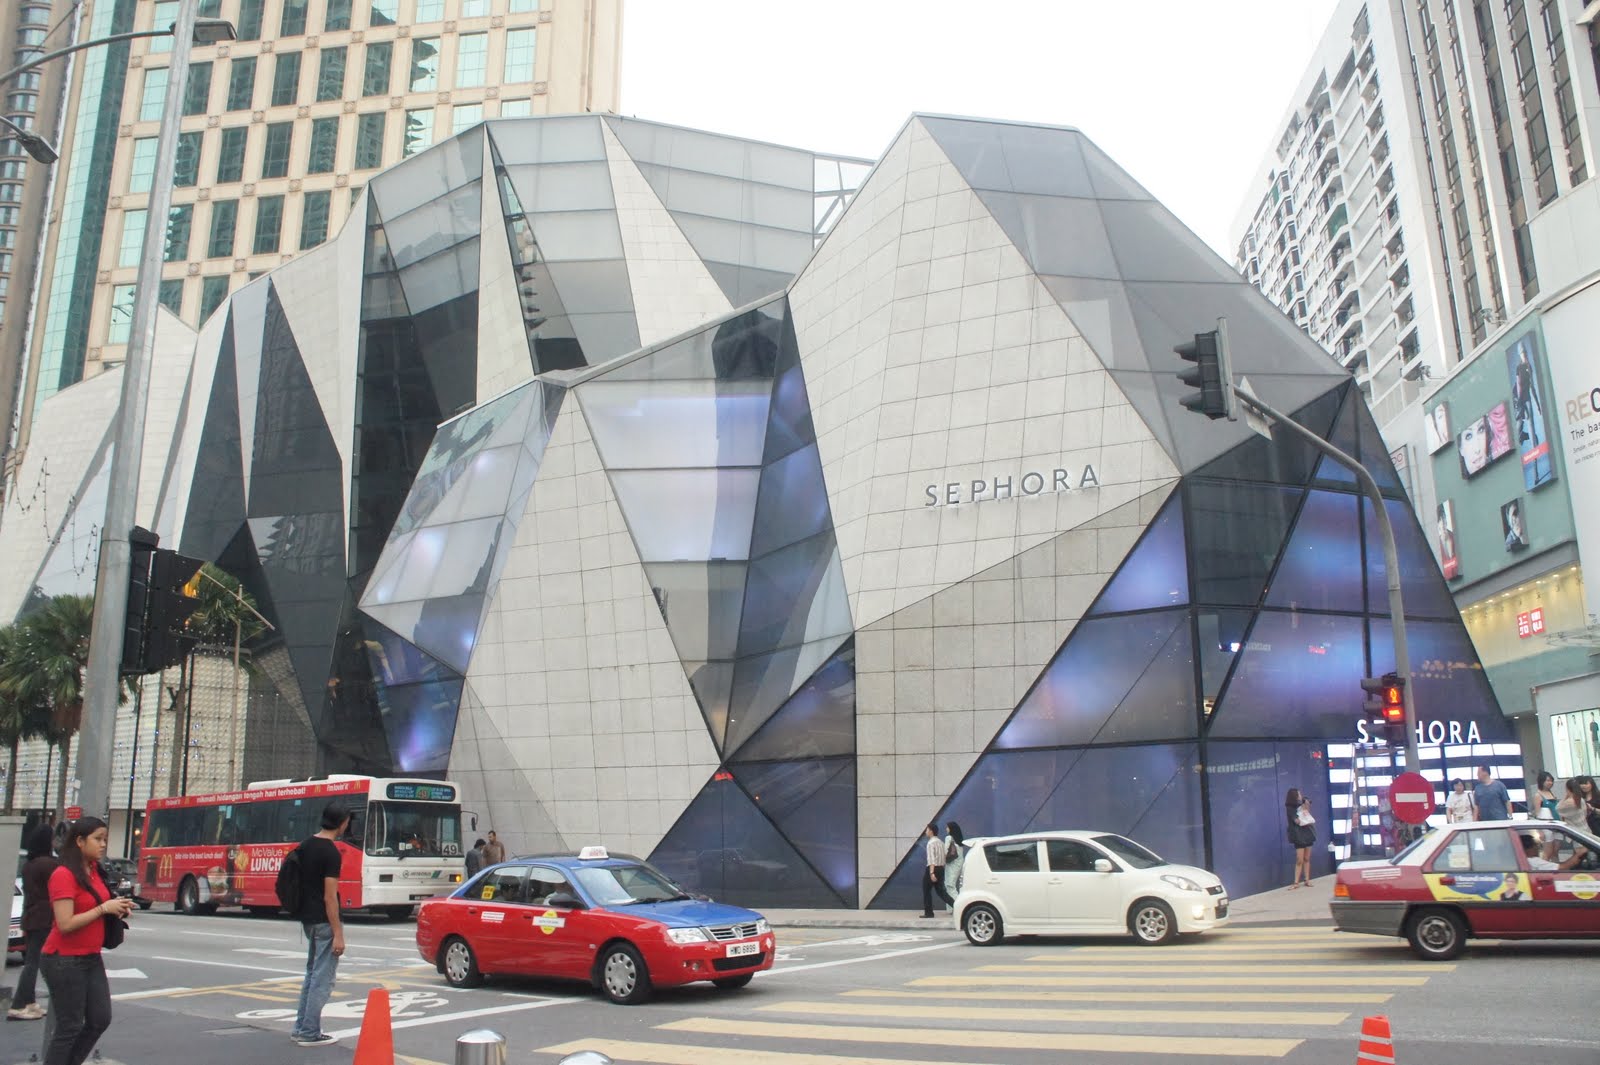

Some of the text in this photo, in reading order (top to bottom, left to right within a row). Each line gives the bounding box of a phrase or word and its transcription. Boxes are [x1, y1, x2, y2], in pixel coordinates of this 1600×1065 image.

[1571, 429, 1585, 440] The
[925, 464, 1099, 507] SEPHORA
[252, 848, 283, 857] McValue
[443, 844, 457, 855] 49
[251, 858, 281, 871] LUNCH
